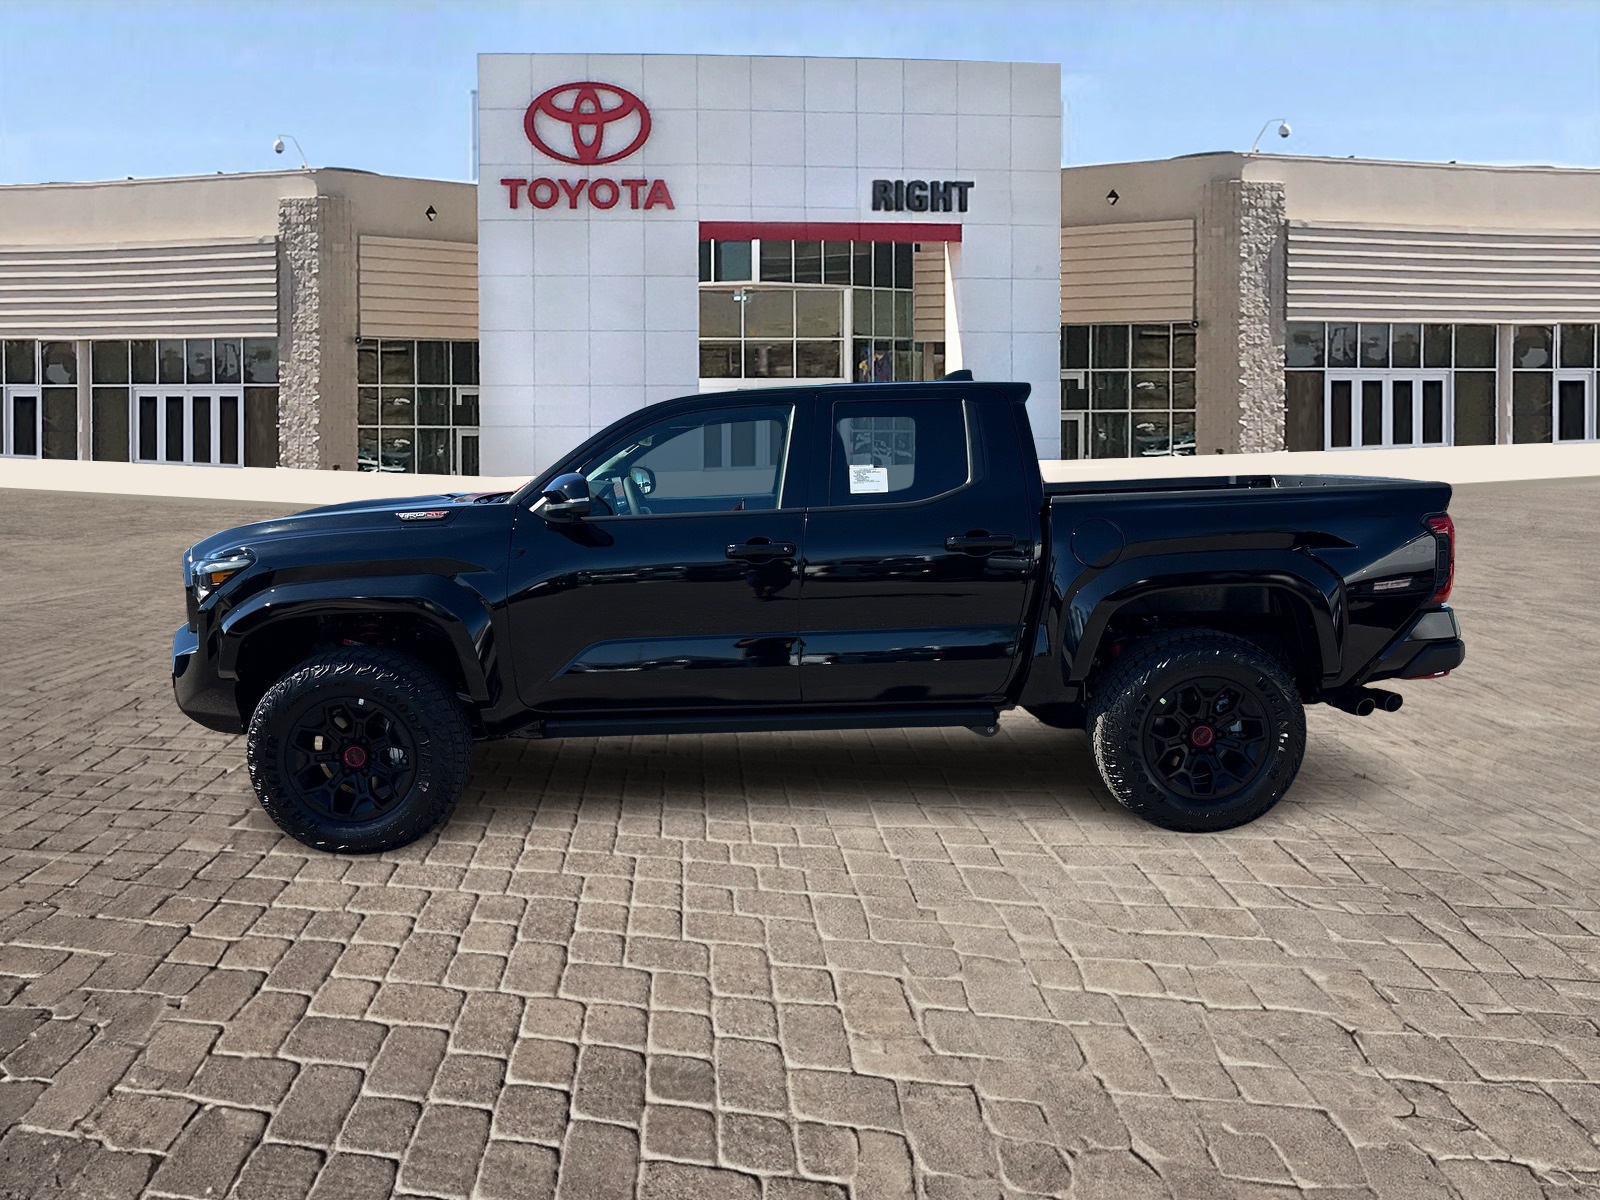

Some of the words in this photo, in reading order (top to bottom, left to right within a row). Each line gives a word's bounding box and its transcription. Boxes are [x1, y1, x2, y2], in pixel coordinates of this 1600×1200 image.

[501, 179, 675, 209] TOYOTA
[872, 181, 975, 212] RIGHT
[372, 687, 432, 792] GOODYEAR
